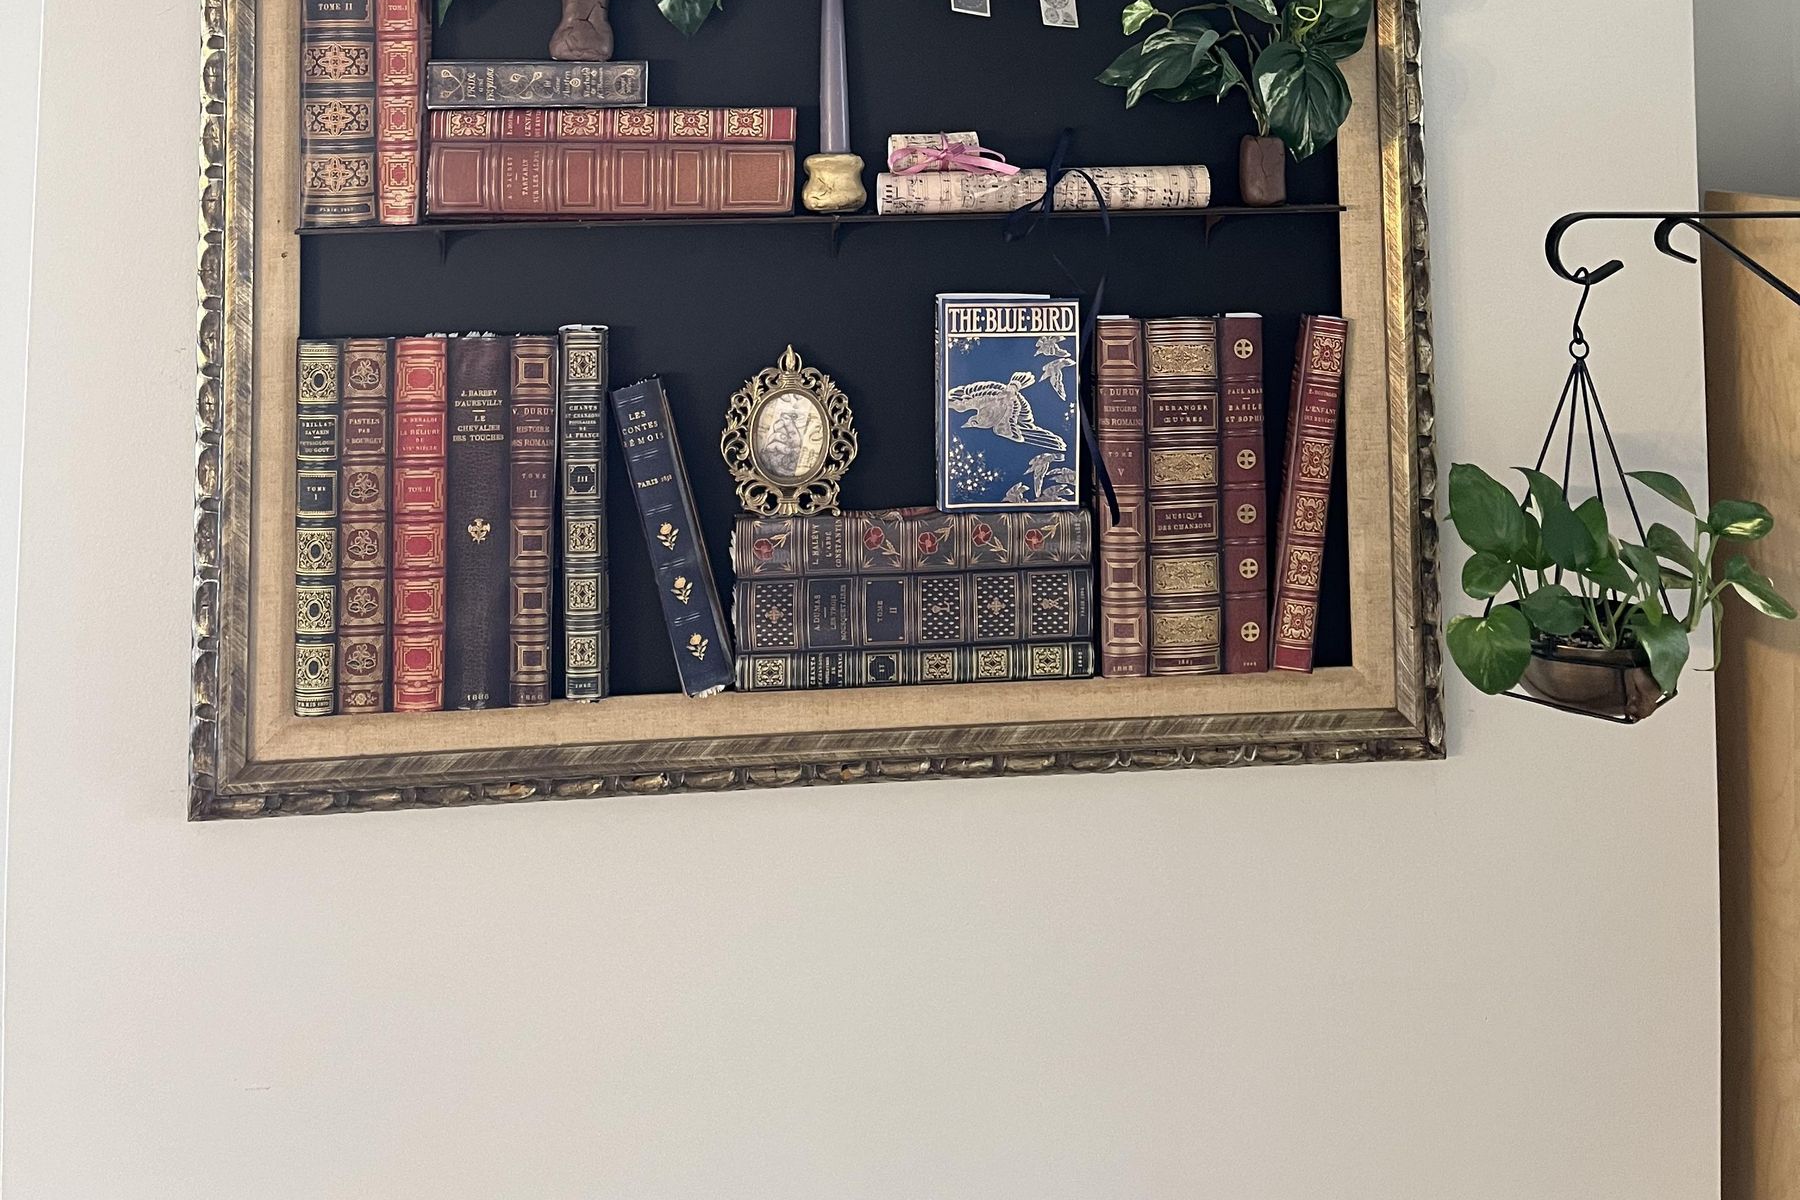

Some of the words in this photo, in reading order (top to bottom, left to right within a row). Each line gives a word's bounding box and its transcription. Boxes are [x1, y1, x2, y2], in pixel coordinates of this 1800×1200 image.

[948, 308, 982, 332] THE
[984, 307, 1028, 332] BLUE
[1030, 306, 1074, 332] BIRD
[1110, 388, 1140, 396] DURUY
[628, 410, 646, 420] LES
[622, 420, 658, 436] CONTES
[470, 434, 504, 442] TOUCHES
[1118, 468, 1124, 476] V
[638, 478, 658, 488] PARIS
[529, 490, 537, 498] II
[1165, 512, 1203, 520] MUSIQUE
